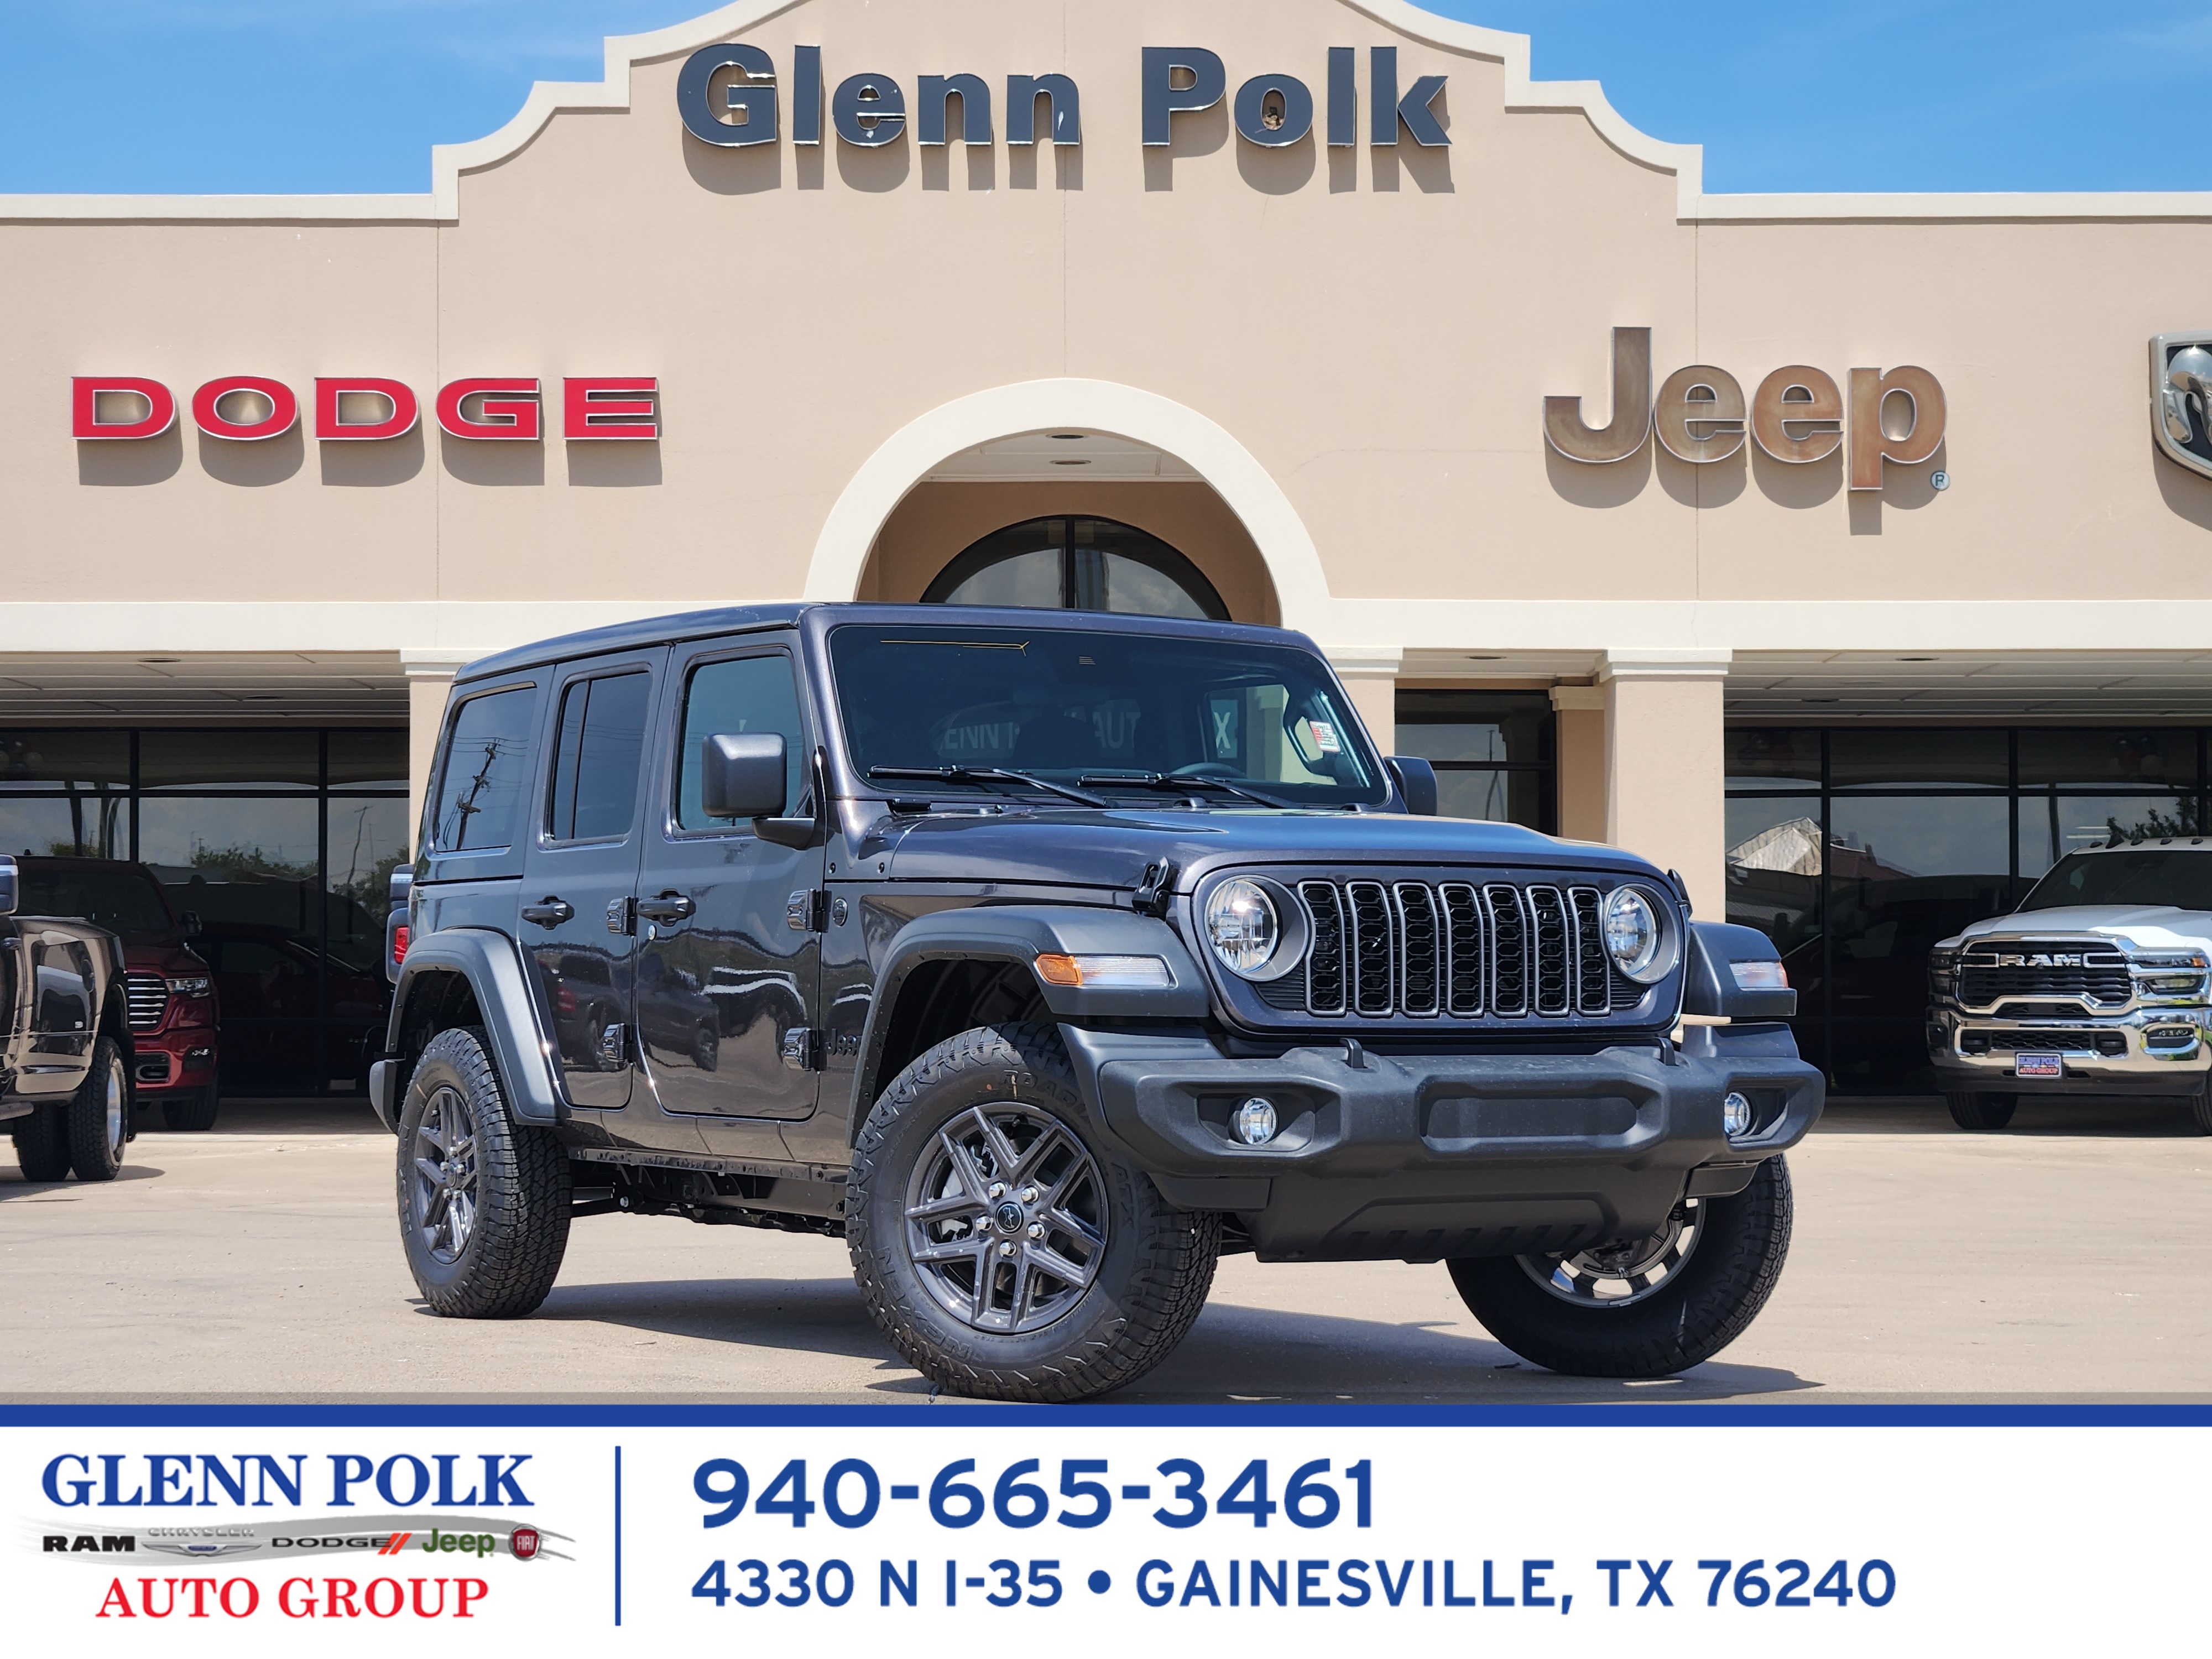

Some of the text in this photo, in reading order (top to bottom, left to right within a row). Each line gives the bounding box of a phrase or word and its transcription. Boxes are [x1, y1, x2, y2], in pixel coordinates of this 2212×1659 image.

[676, 43, 1453, 149] Glenn Polk
[70, 375, 659, 441] DODGE
[1543, 326, 1947, 491] Jeep
[1999, 954, 2081, 967] RAM
[825, 1027, 862, 1057] Jee
[999, 1069, 1091, 1123] ROADI
